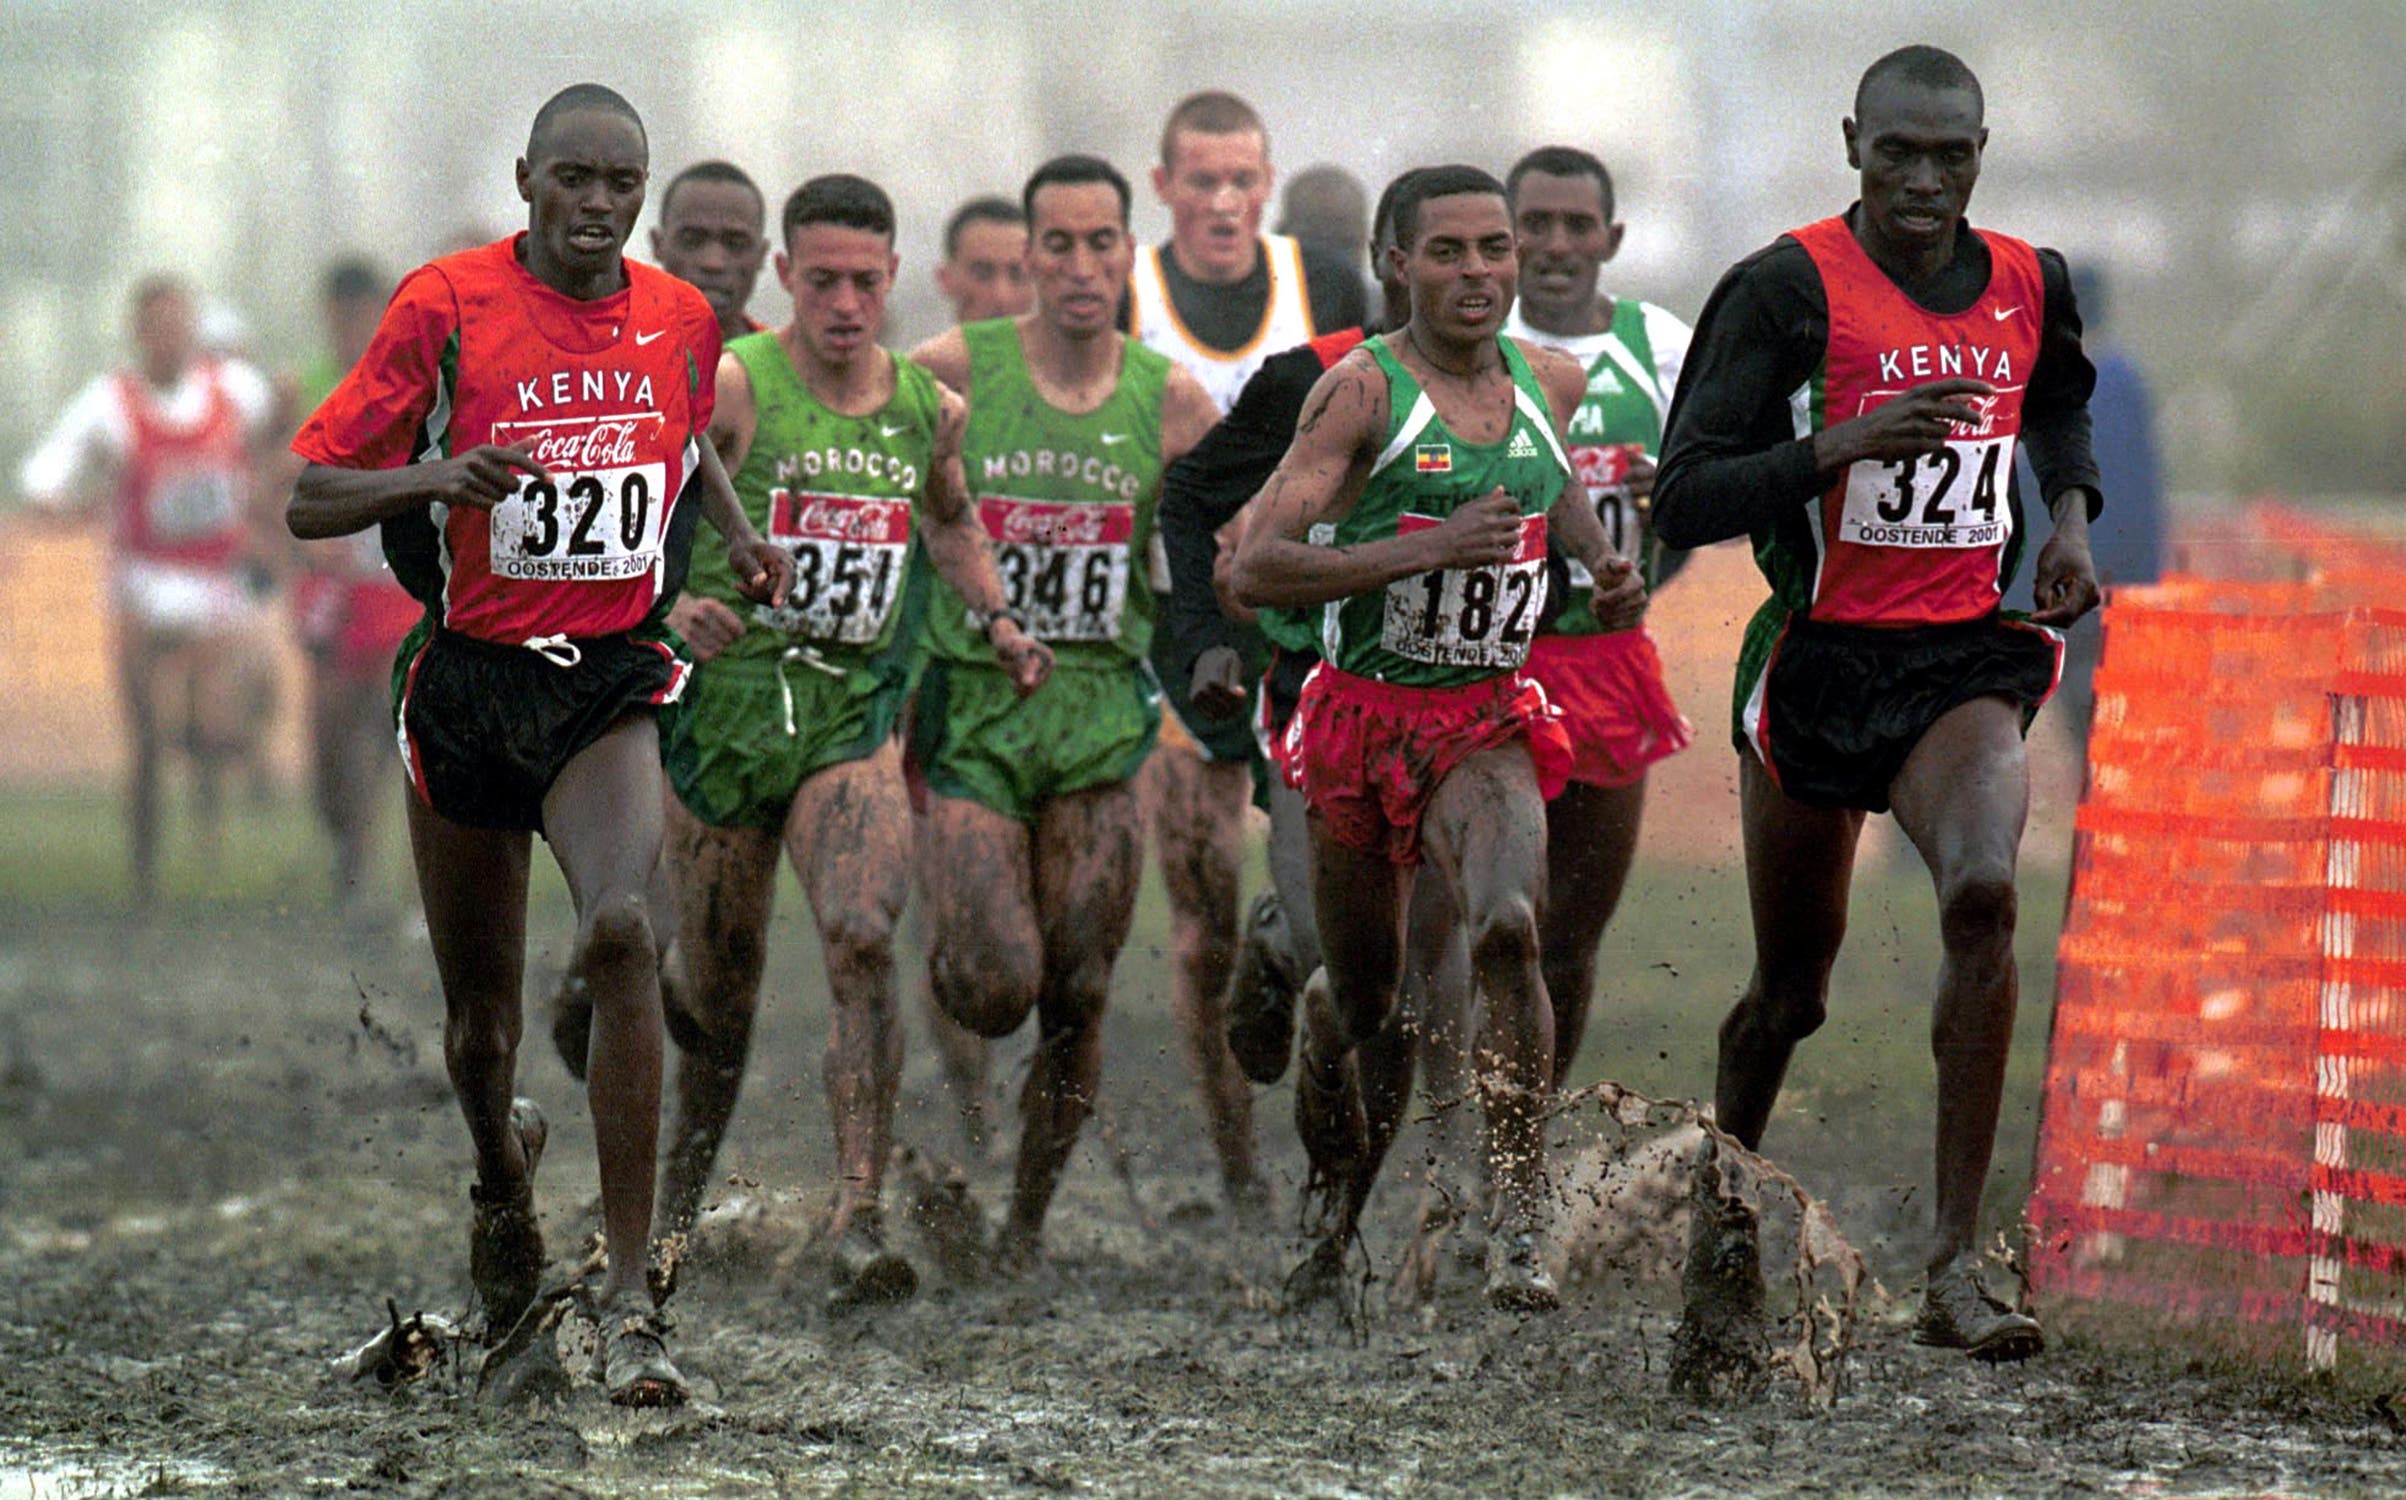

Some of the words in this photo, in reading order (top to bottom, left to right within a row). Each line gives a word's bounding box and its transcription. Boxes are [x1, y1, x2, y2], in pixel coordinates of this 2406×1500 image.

[1879, 344, 2011, 382] KENYA
[517, 370, 655, 412] KENYA
[776, 448, 917, 490] MOROCCO
[983, 450, 1140, 498] MOROCCO
[1877, 442, 2001, 524] 324
[522, 472, 649, 557] 320
[1859, 526, 1958, 545] OOSTENDE
[1967, 526, 1999, 543] 2001
[507, 560, 612, 577] OOSTENDE
[623, 555, 649, 575] 2001
[788, 543, 893, 617] 351
[1000, 547, 1112, 616] 346
[1420, 568, 1533, 642] 182
